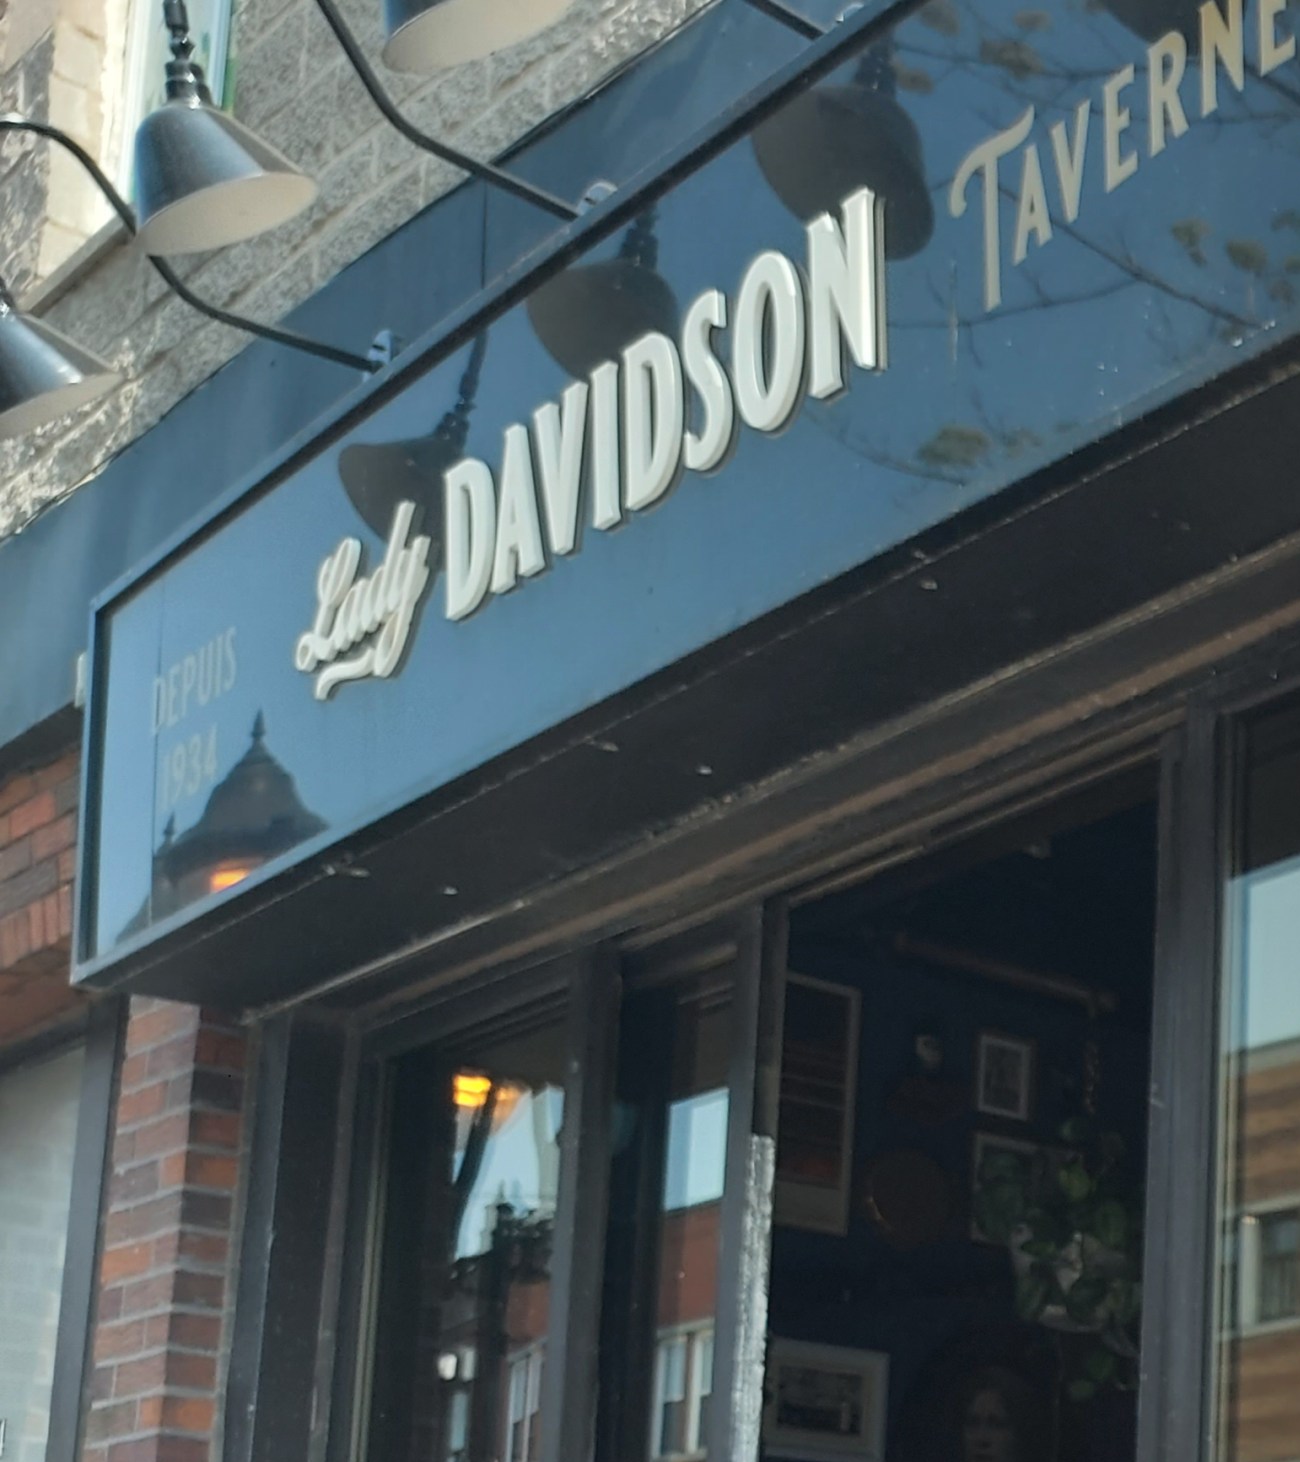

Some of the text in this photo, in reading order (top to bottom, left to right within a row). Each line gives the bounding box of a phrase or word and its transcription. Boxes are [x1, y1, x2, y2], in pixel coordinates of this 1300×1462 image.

[296, 0, 1296, 700] Lady DAVIDSON TAVERNE
[153, 626, 237, 736] DEPUIS
[158, 722, 218, 814] 1934
